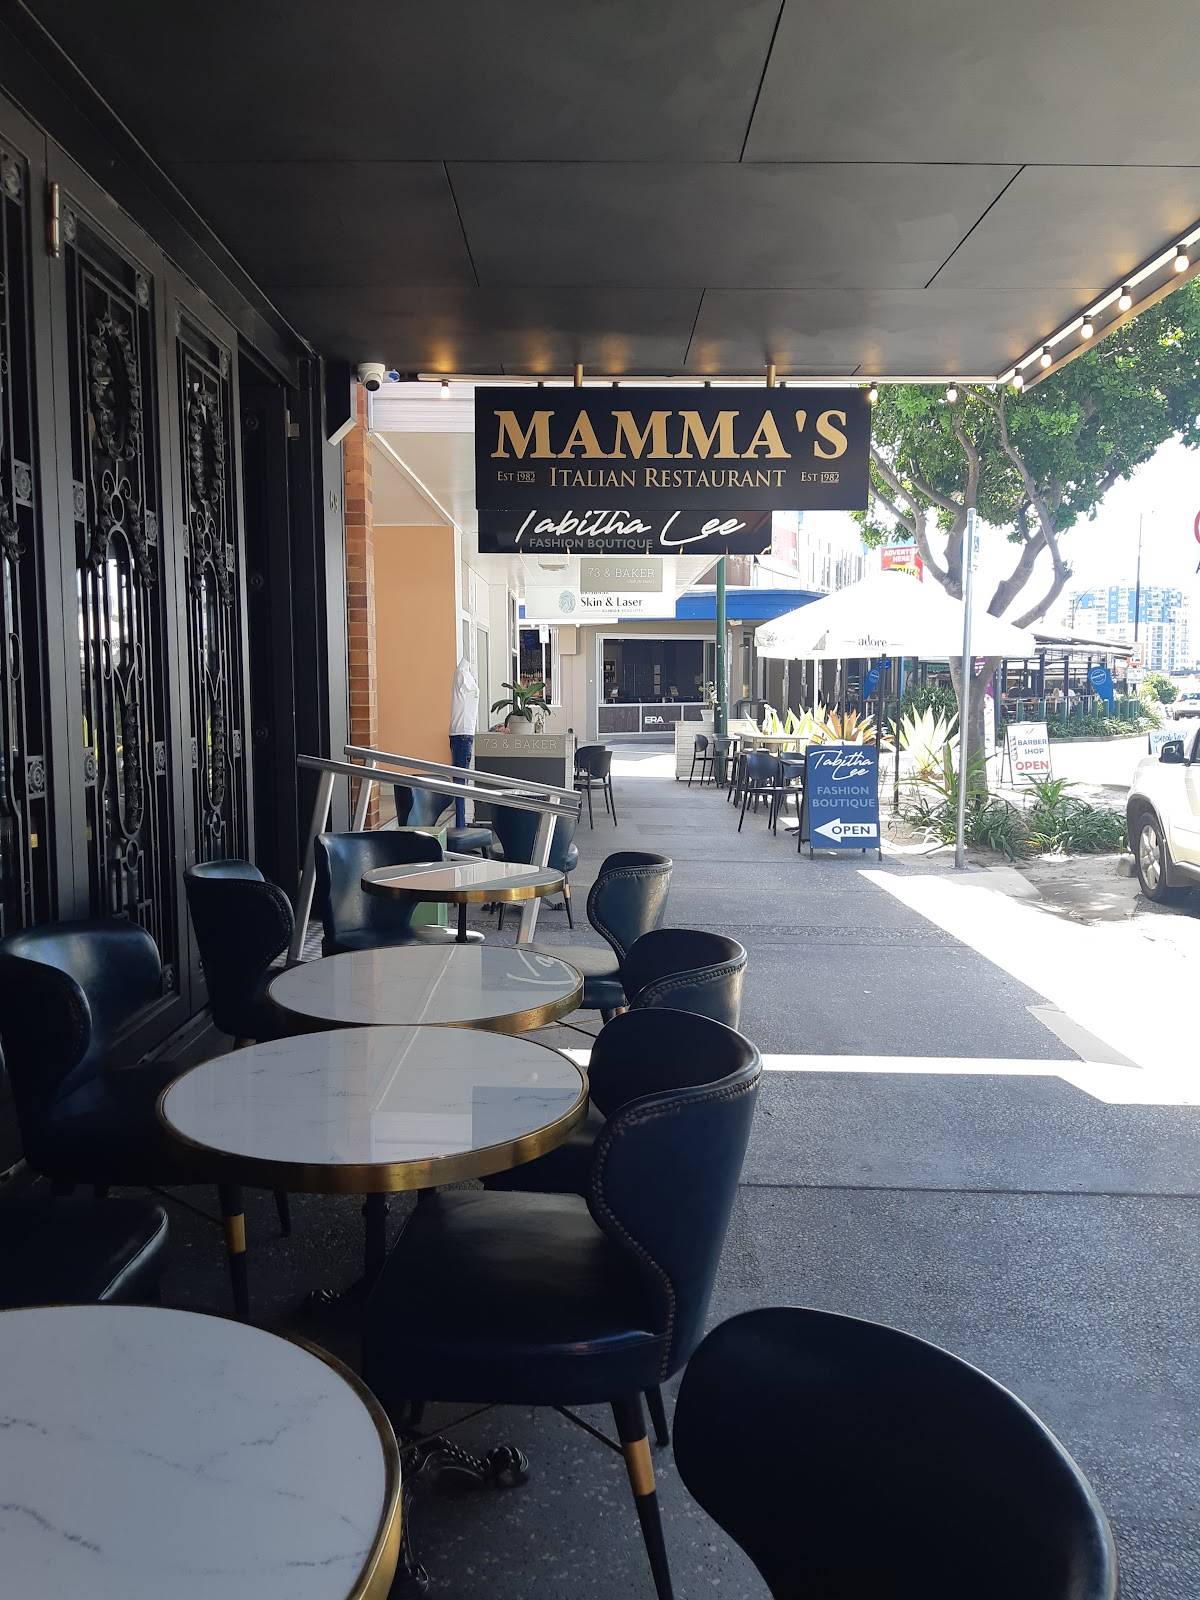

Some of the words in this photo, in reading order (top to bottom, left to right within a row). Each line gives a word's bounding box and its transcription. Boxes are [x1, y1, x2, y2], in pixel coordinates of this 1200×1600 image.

[490, 409, 849, 460] MAMMA'S
[497, 471, 514, 481] EST
[517, 470, 536, 482] 1982
[550, 467, 637, 487] ITALIAN
[645, 467, 787, 487] RESTAURANT
[801, 471, 817, 482] EST
[820, 471, 840, 483] 1982
[529, 538, 584, 549] FASHION
[587, 538, 654, 550] BOUTIQUE
[587, 567, 601, 578] 73
[604, 567, 611, 578] &
[615, 567, 655, 578] BAKER
[580, 596, 602, 607] Skin
[605, 596, 613, 607] &
[617, 596, 643, 607] Laser
[858, 634, 888, 647] adore
[645, 716, 664, 724] ERA
[483, 738, 498, 749] 73
[502, 738, 509, 749] &
[514, 739, 557, 750] BAKER
[1017, 738, 1047, 746] BARBER
[809, 749, 875, 770] Tabitha
[1015, 760, 1049, 770] OPEN
[831, 763, 870, 781] Lee
[817, 786, 870, 796] FASHION
[812, 798, 876, 809] BOUTIQUE
[831, 825, 871, 836] OPEN
